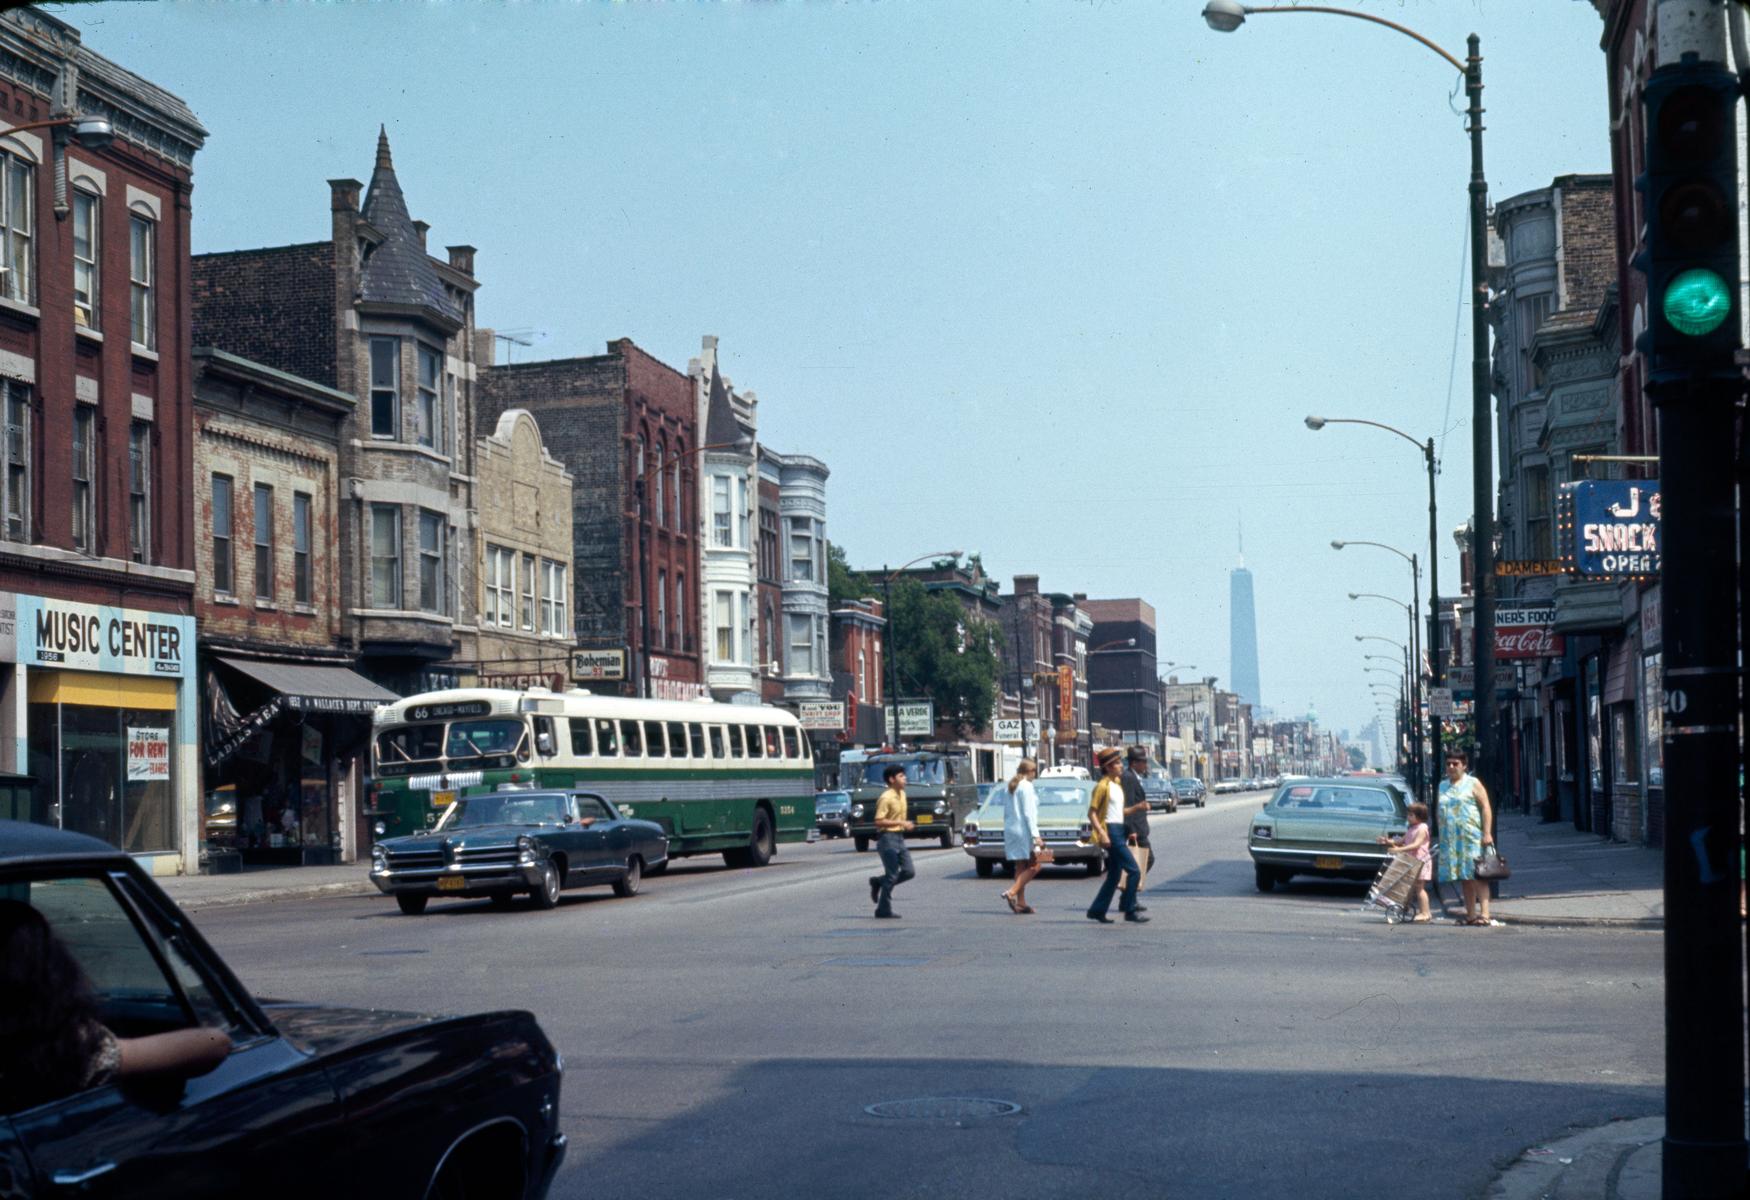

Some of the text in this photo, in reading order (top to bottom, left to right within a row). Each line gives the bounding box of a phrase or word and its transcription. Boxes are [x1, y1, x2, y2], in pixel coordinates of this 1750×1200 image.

[1609, 486, 1639, 517] J
[1583, 523, 1656, 552] SNACK
[1505, 560, 1549, 574] DAMEN
[1602, 554, 1650, 572] OPEN
[1496, 610, 1526, 625] NER'S
[0, 622, 14, 635] TIST
[36, 608, 181, 660] MUSIC CENTER
[1495, 628, 1554, 651] ca-Cola
[575, 653, 620, 672] Bohemian
[414, 704, 429, 719] 66
[887, 707, 929, 717] ISA VERDE
[998, 720, 1036, 729] GAZA
[129, 741, 168, 758] FOR RENT
